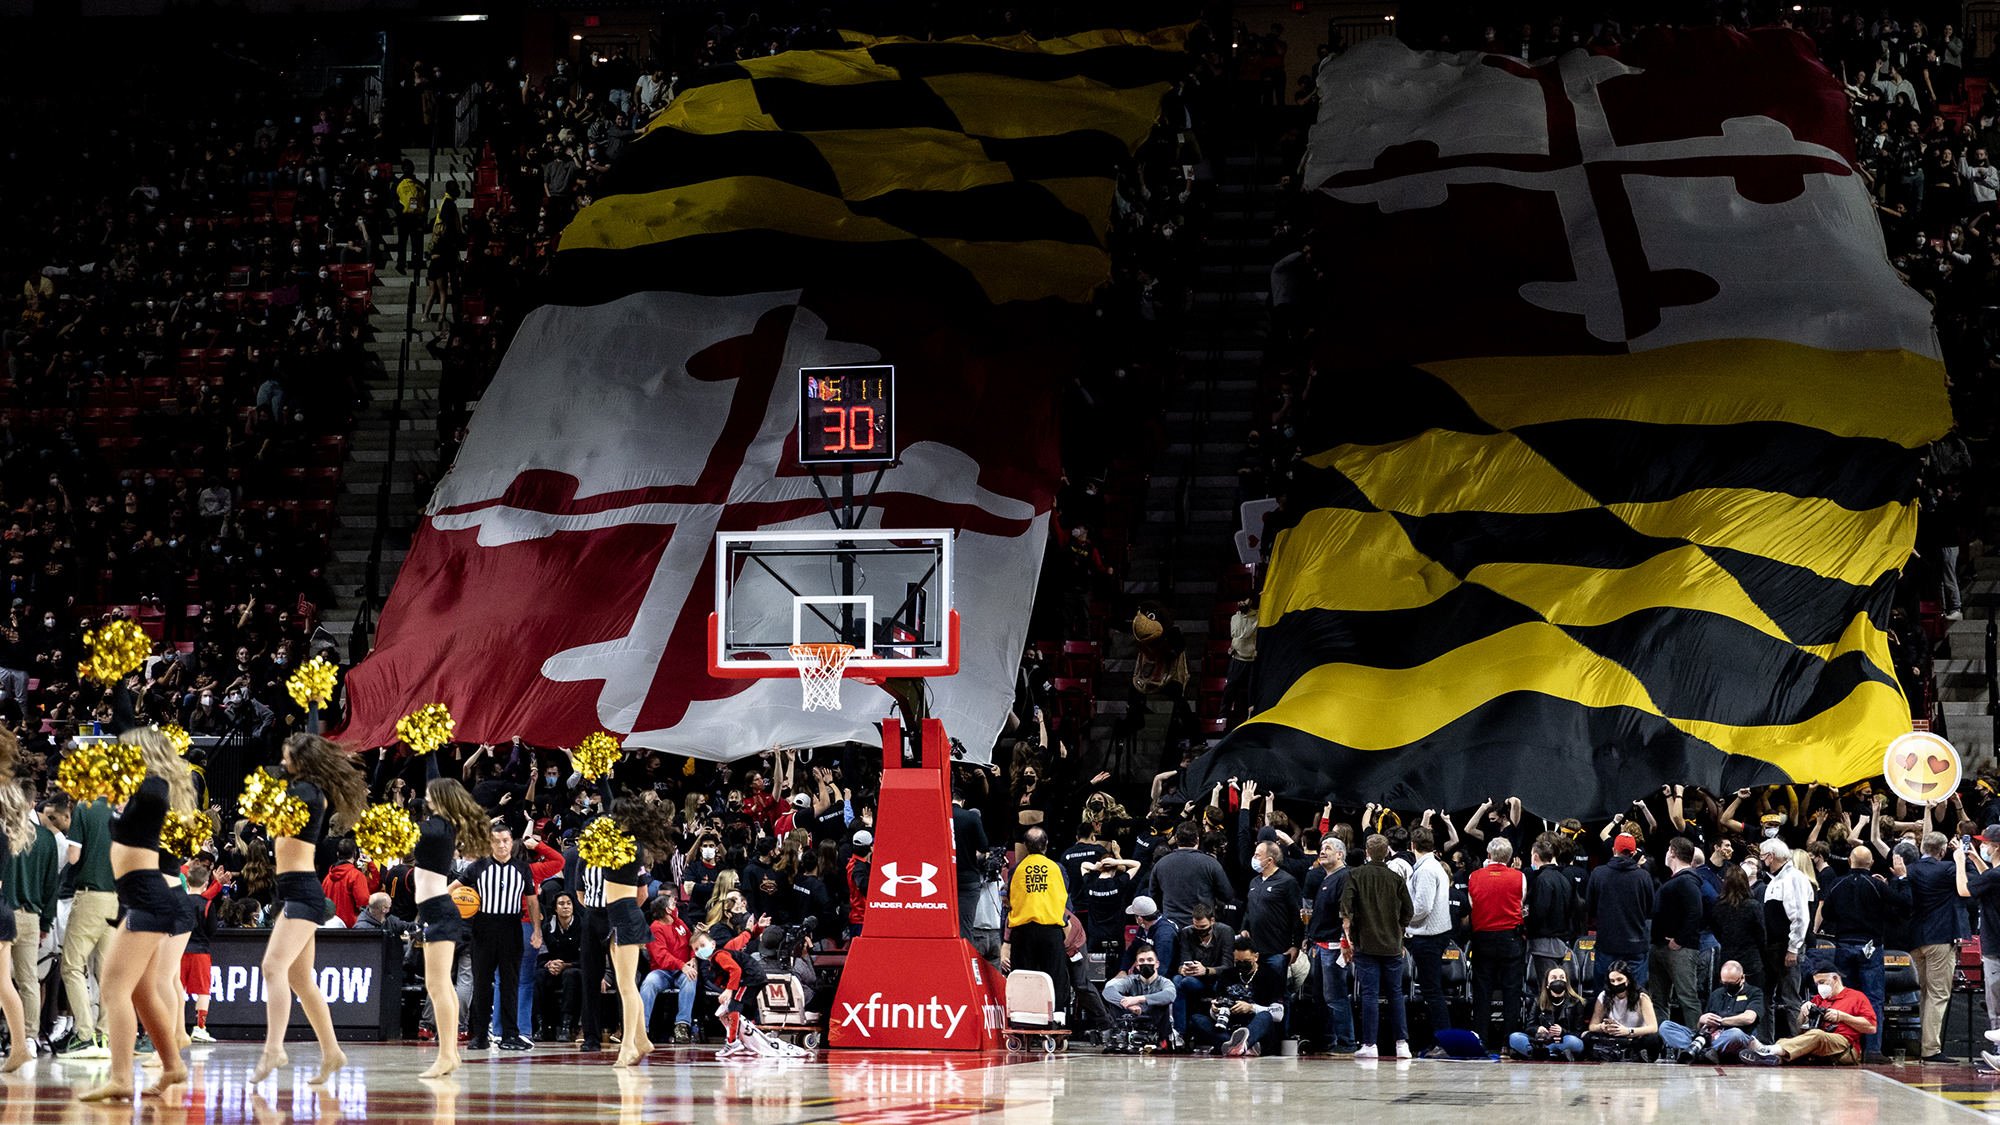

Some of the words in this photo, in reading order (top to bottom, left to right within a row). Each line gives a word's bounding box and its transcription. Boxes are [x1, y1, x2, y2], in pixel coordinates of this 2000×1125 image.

[823, 406, 874, 451] 30
[1025, 865, 1049, 874] CSC
[1025, 874, 1048, 884] EVENT
[1026, 884, 1048, 893] STAFF
[904, 902, 948, 910] ARMOUR
[768, 984, 785, 999] M
[841, 992, 968, 1039] xfinity
